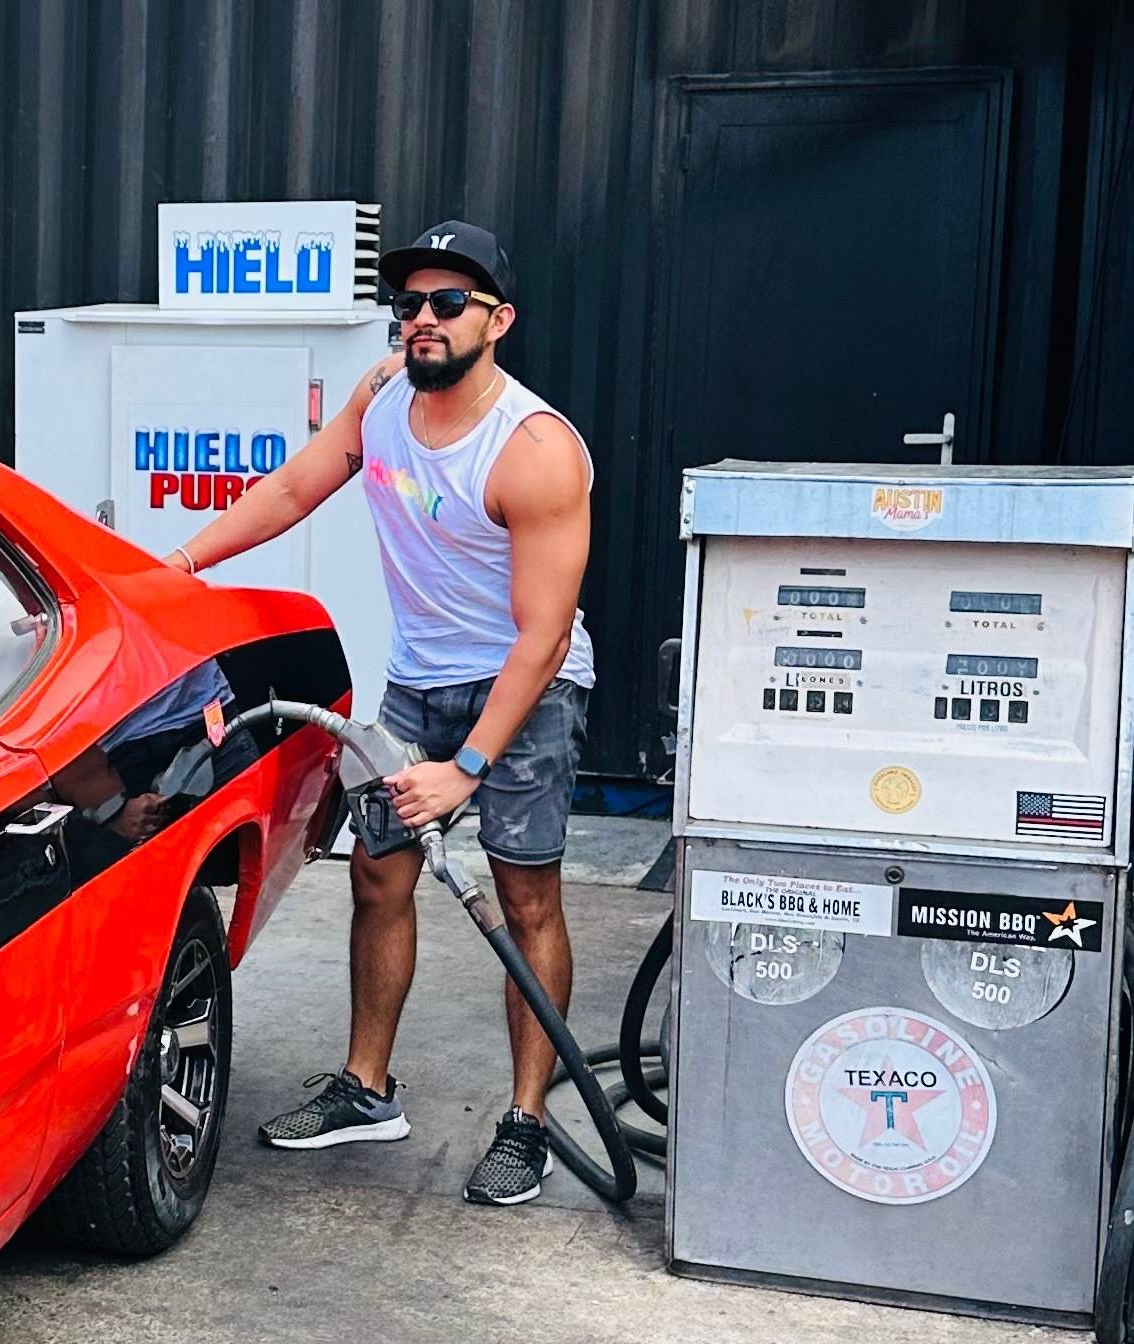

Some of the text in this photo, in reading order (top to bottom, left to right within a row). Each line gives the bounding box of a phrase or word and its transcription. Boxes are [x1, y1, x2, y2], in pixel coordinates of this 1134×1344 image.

[174, 230, 334, 294] HIELO
[135, 424, 286, 474] HIELO
[801, 612, 843, 621] TOTAL
[972, 620, 1016, 629] TOTAL
[960, 680, 1024, 697] LITROS
[743, 877, 765, 887] Only
[721, 890, 861, 917] BLACK'S BBQ & HOME
[912, 905, 1036, 934] MISSION BBQ
[750, 932, 798, 954] DLS
[967, 929, 980, 937] The
[982, 930, 1017, 940] American
[755, 960, 792, 979] 500
[970, 951, 1021, 977] DLS
[971, 981, 1011, 1004] 500
[799, 1016, 980, 1088] GASOLINE
[844, 1069, 937, 1088] TEXACO
[870, 1090, 908, 1130] T
[799, 1119, 984, 1195] MOTOR OIL
